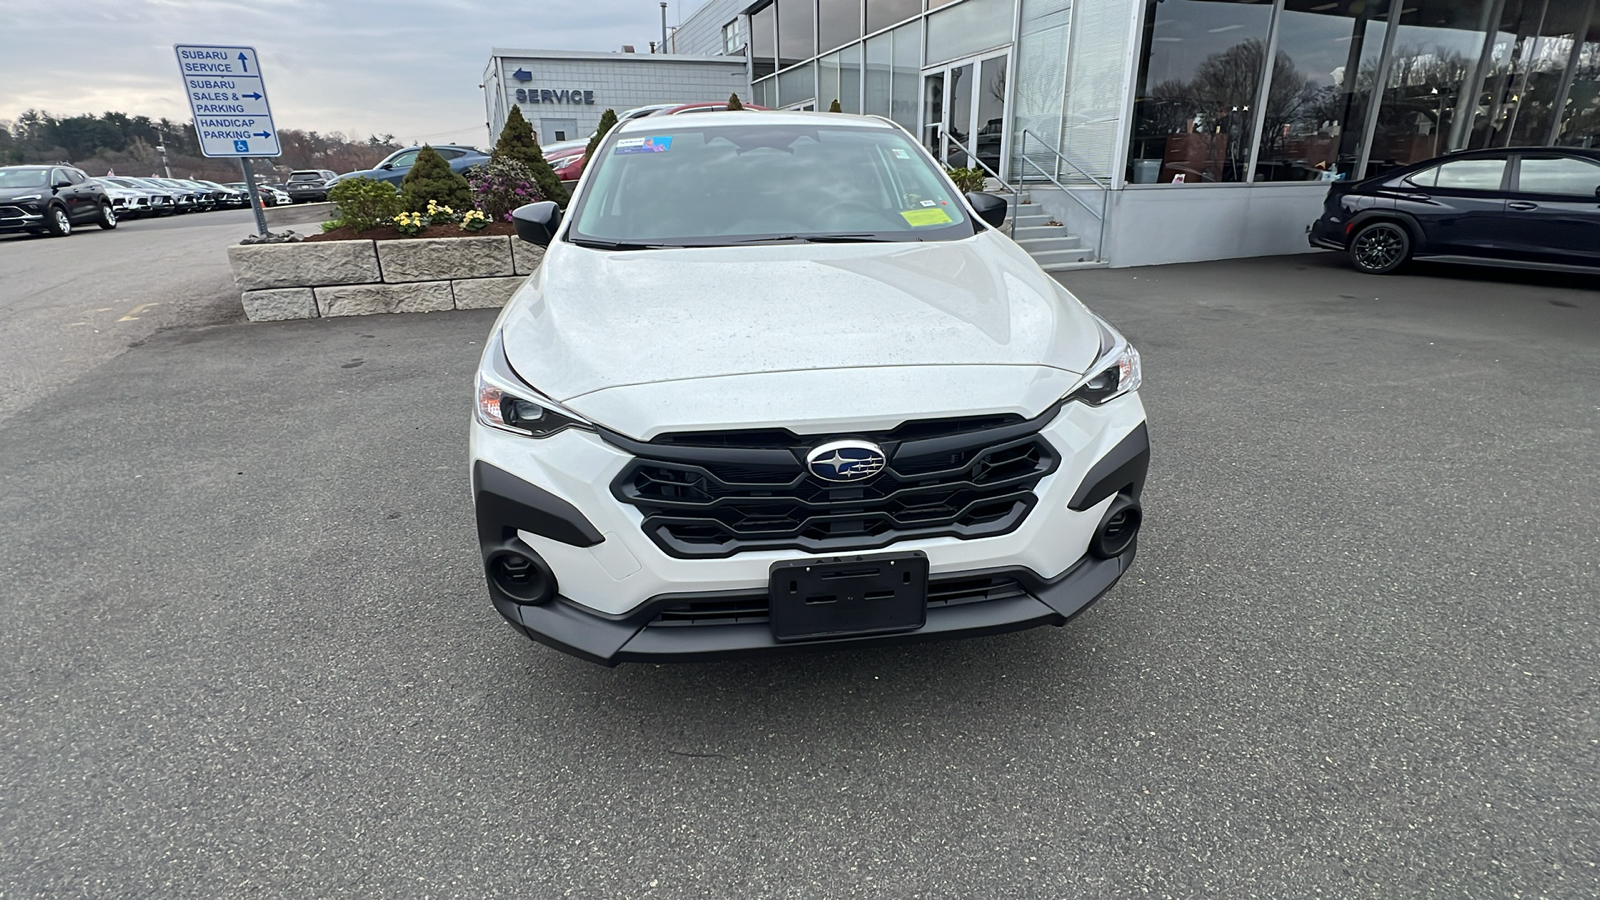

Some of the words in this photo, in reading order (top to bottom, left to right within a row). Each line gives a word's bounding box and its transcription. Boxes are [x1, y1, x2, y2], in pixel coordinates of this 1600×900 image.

[181, 50, 228, 60] SUBARU
[185, 63, 232, 72] SERVICE
[190, 80, 235, 89] SUBARU
[193, 92, 229, 101] SALES
[231, 92, 239, 101] &
[515, 88, 595, 105] SERVICE
[196, 104, 244, 113] PARKING
[200, 119, 255, 128] HANDICAP
[203, 131, 251, 139] PARKING
